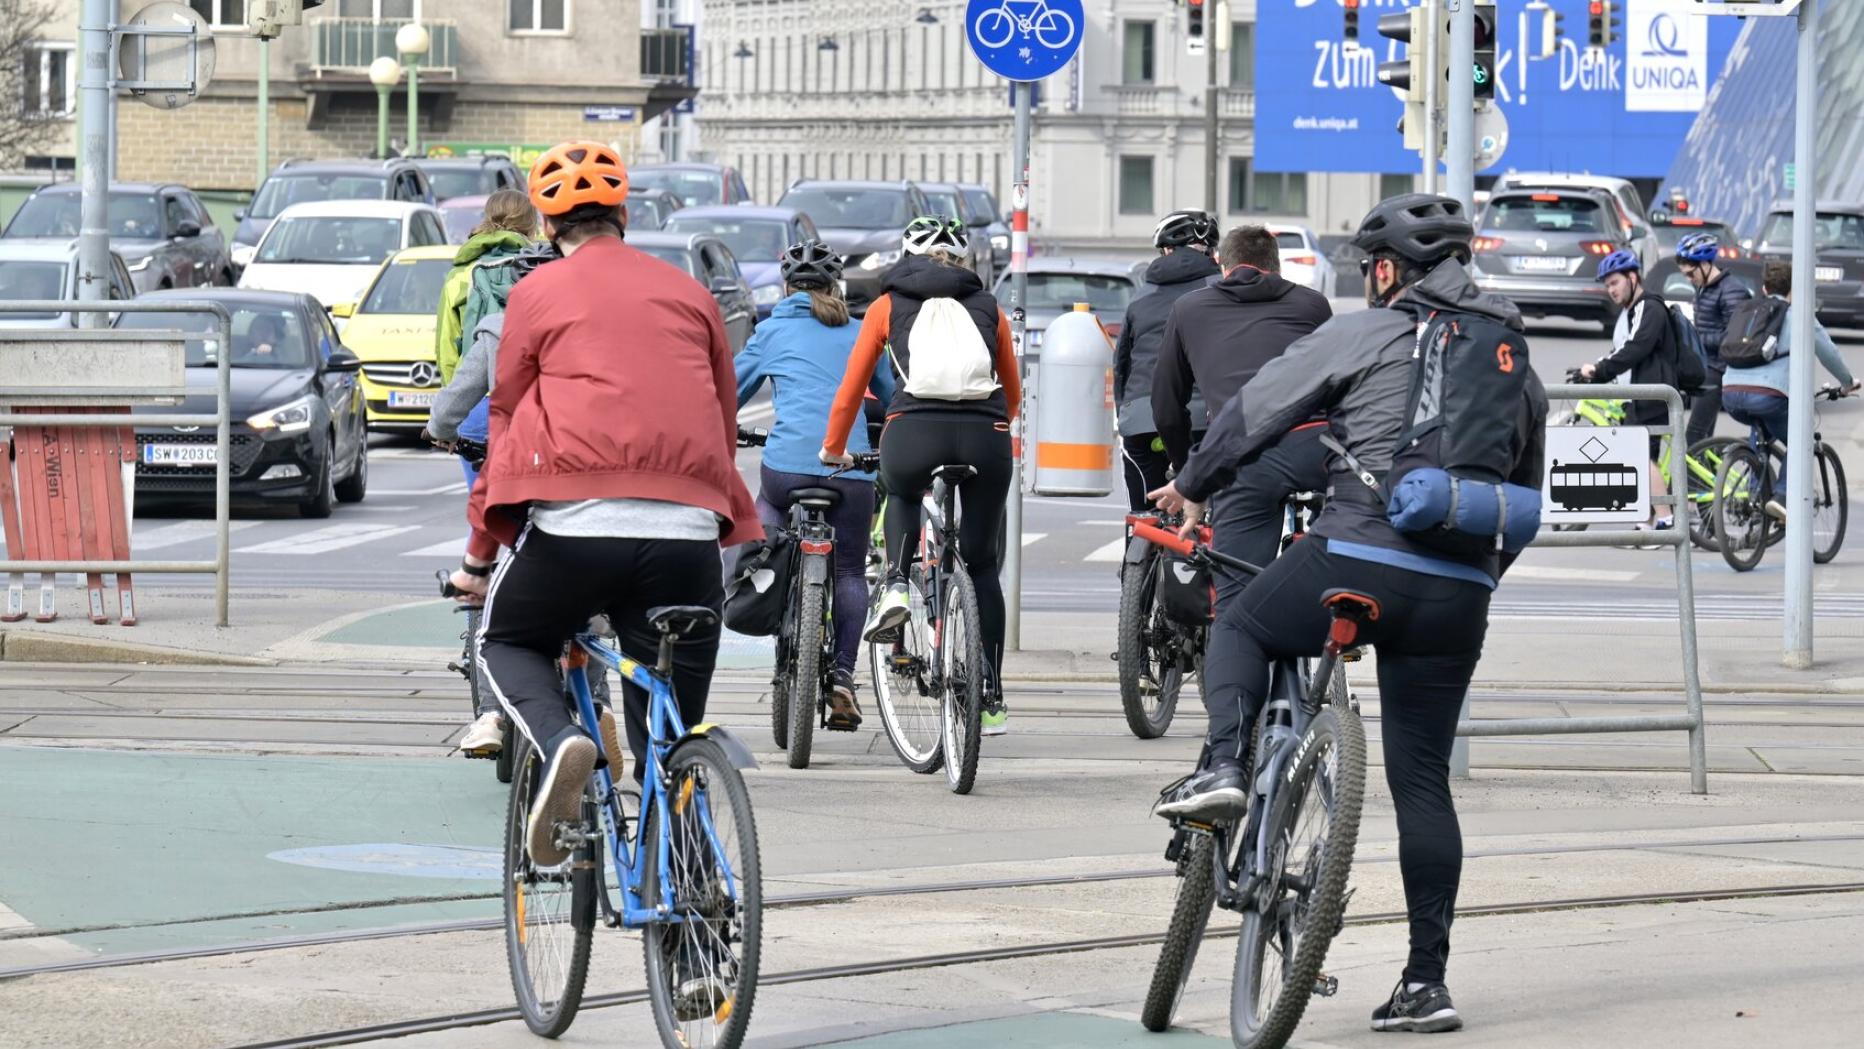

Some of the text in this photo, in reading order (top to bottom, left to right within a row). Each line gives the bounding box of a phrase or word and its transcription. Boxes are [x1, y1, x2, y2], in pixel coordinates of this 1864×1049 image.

[1312, 40, 1376, 89] zum
[1559, 38, 1622, 91] Denk
[1632, 67, 1699, 90] UNIQA
[1293, 116, 1359, 131] denk.uniqa.at
[154, 448, 172, 461] SW
